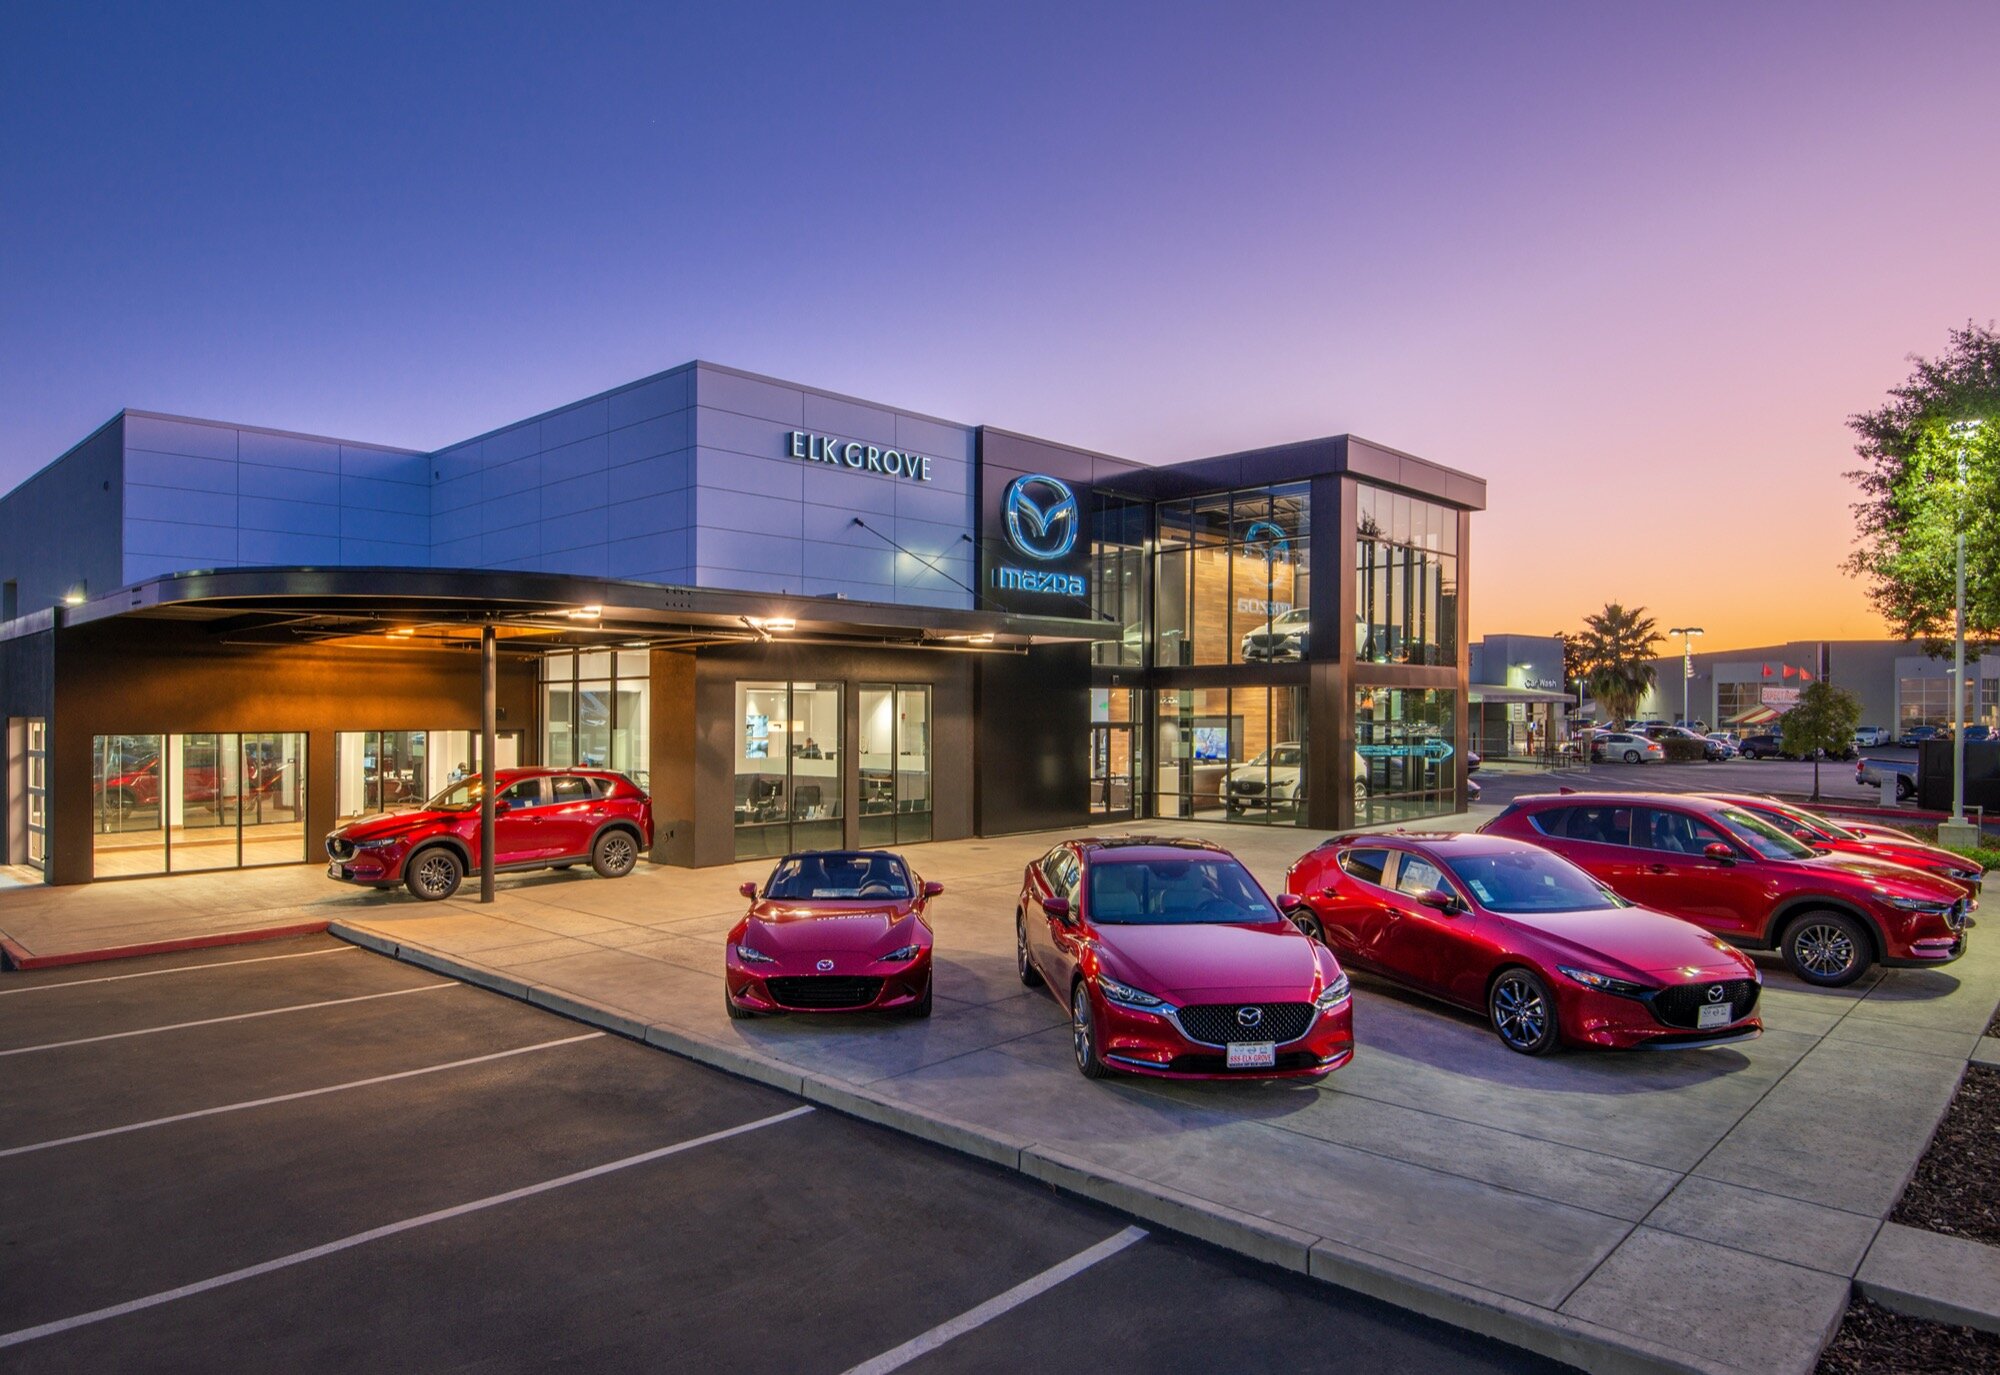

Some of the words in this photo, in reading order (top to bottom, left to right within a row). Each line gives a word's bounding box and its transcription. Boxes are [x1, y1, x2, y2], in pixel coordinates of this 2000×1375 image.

[791, 431, 839, 464] ELK
[843, 442, 932, 481] GROVE
[999, 566, 1085, 596] mazda
[1525, 679, 1539, 689] Car
[1539, 678, 1557, 688] Wash
